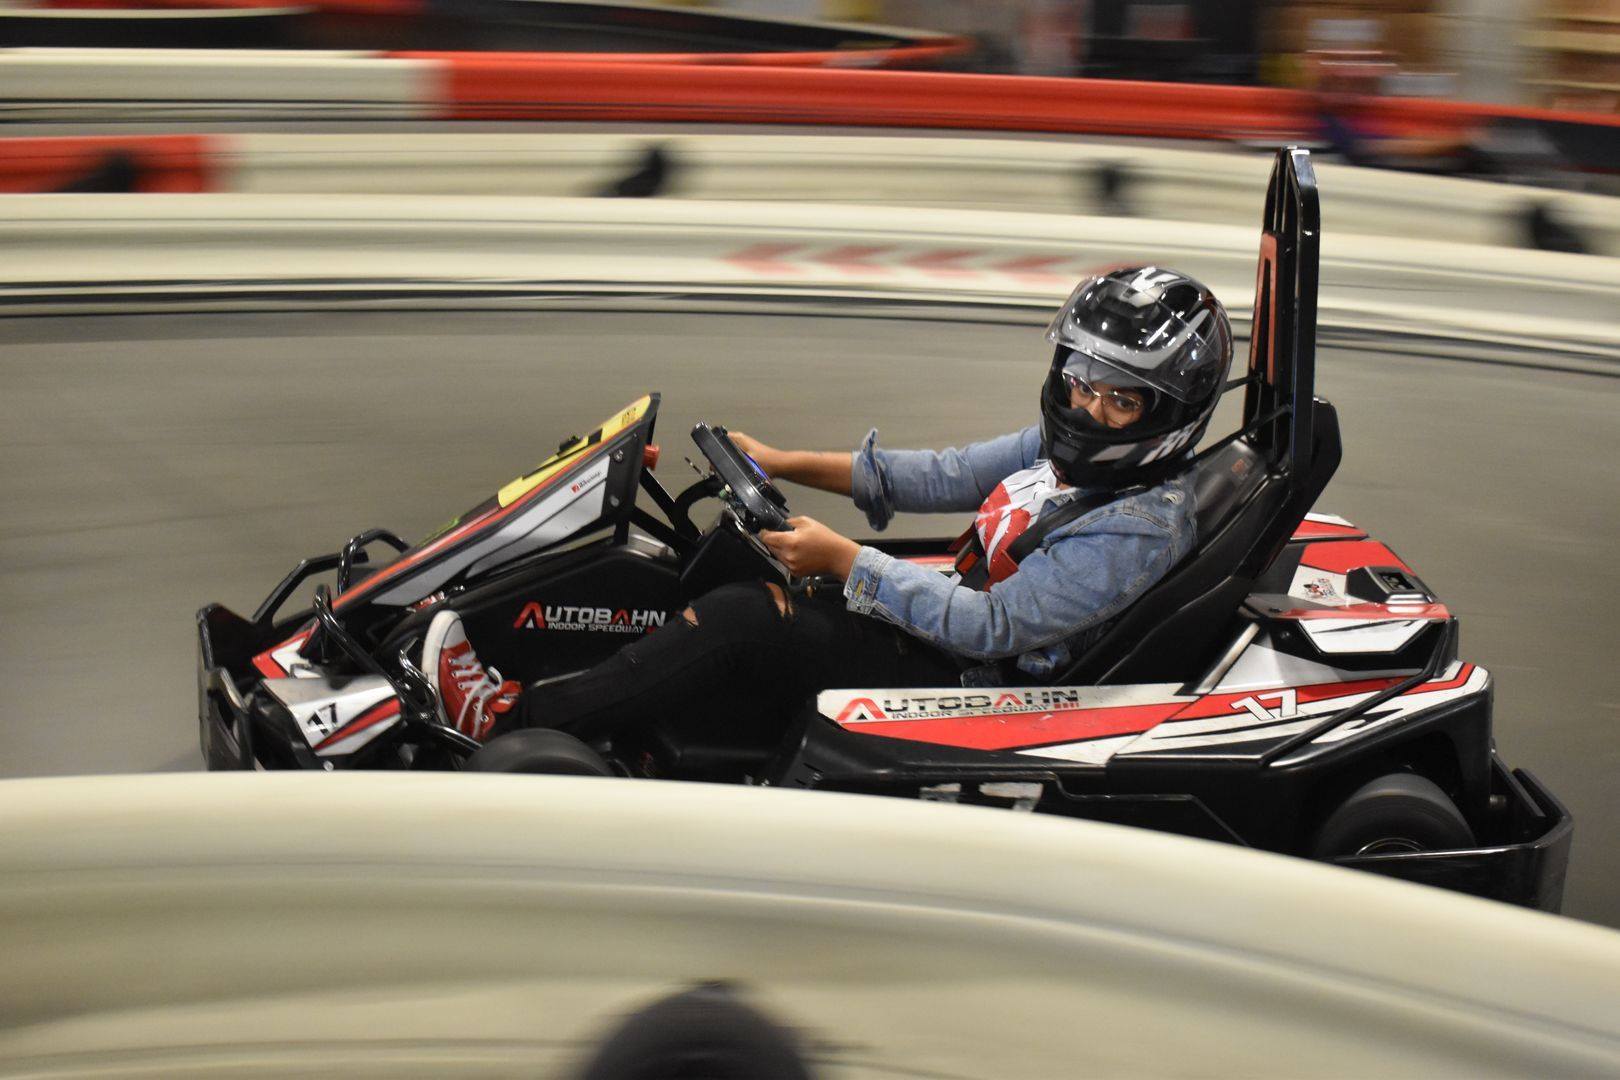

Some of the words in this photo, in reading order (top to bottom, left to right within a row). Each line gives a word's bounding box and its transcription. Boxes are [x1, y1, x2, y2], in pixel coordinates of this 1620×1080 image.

[513, 601, 666, 629] AUTOBAHN
[548, 622, 586, 631] INDOOR
[588, 624, 645, 634] SPEEDWAY
[306, 702, 339, 737] 17
[1229, 687, 1298, 721] 17
